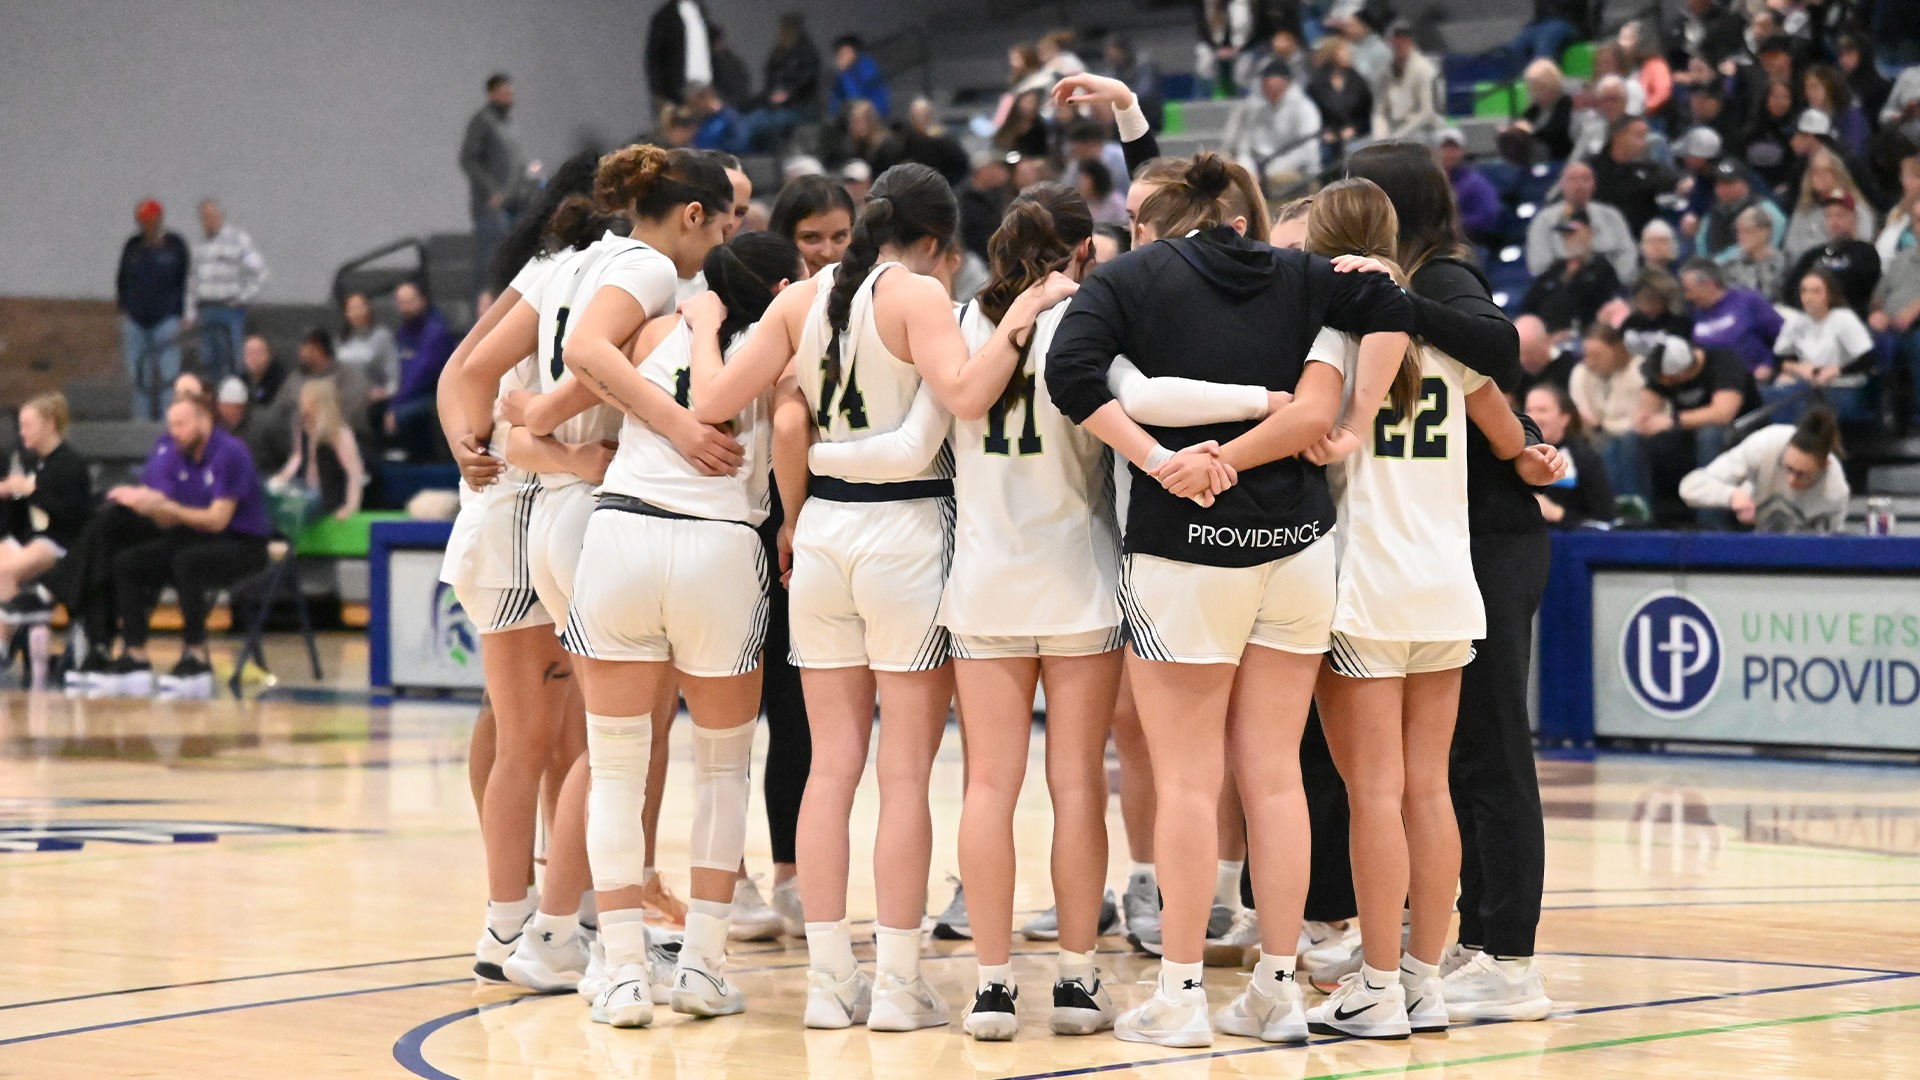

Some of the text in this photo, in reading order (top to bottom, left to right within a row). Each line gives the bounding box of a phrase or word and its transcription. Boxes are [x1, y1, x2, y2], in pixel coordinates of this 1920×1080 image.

[983, 371, 1044, 457] 11
[1373, 375, 1449, 459] 22
[1187, 520, 1321, 548] PROVIDENCE
[1741, 611, 1920, 648] UNIVERS
[1743, 655, 1920, 706] PROVID
